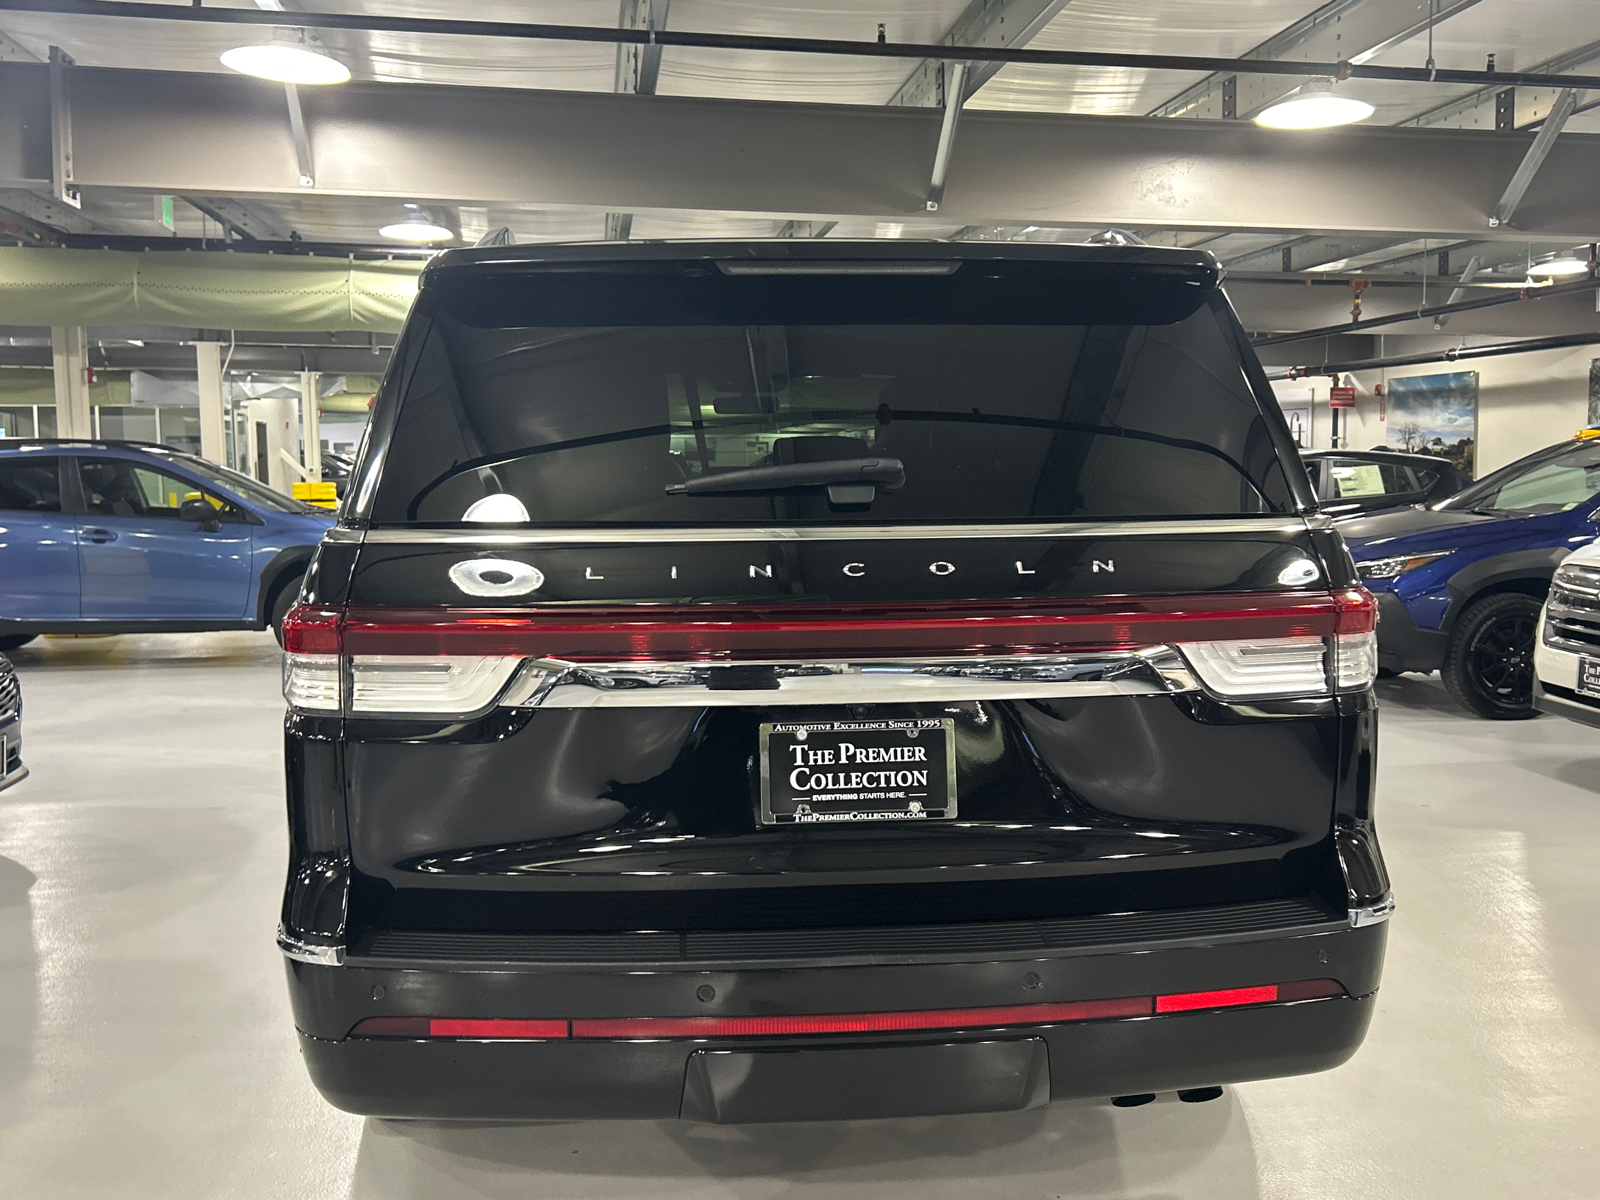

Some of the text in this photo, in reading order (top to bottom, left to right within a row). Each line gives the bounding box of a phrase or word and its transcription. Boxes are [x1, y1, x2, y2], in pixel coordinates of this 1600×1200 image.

[585, 558, 1117, 581] LINCOLN
[774, 719, 941, 732] AUTOMOTIVE EXCELLENCE SINCE 1995
[789, 743, 927, 766] THE PREMIER
[789, 767, 928, 791] COLLECTION
[812, 793, 858, 801] EVERYTHING
[793, 811, 927, 822] THEPREMIERCOLLECTION.COM
